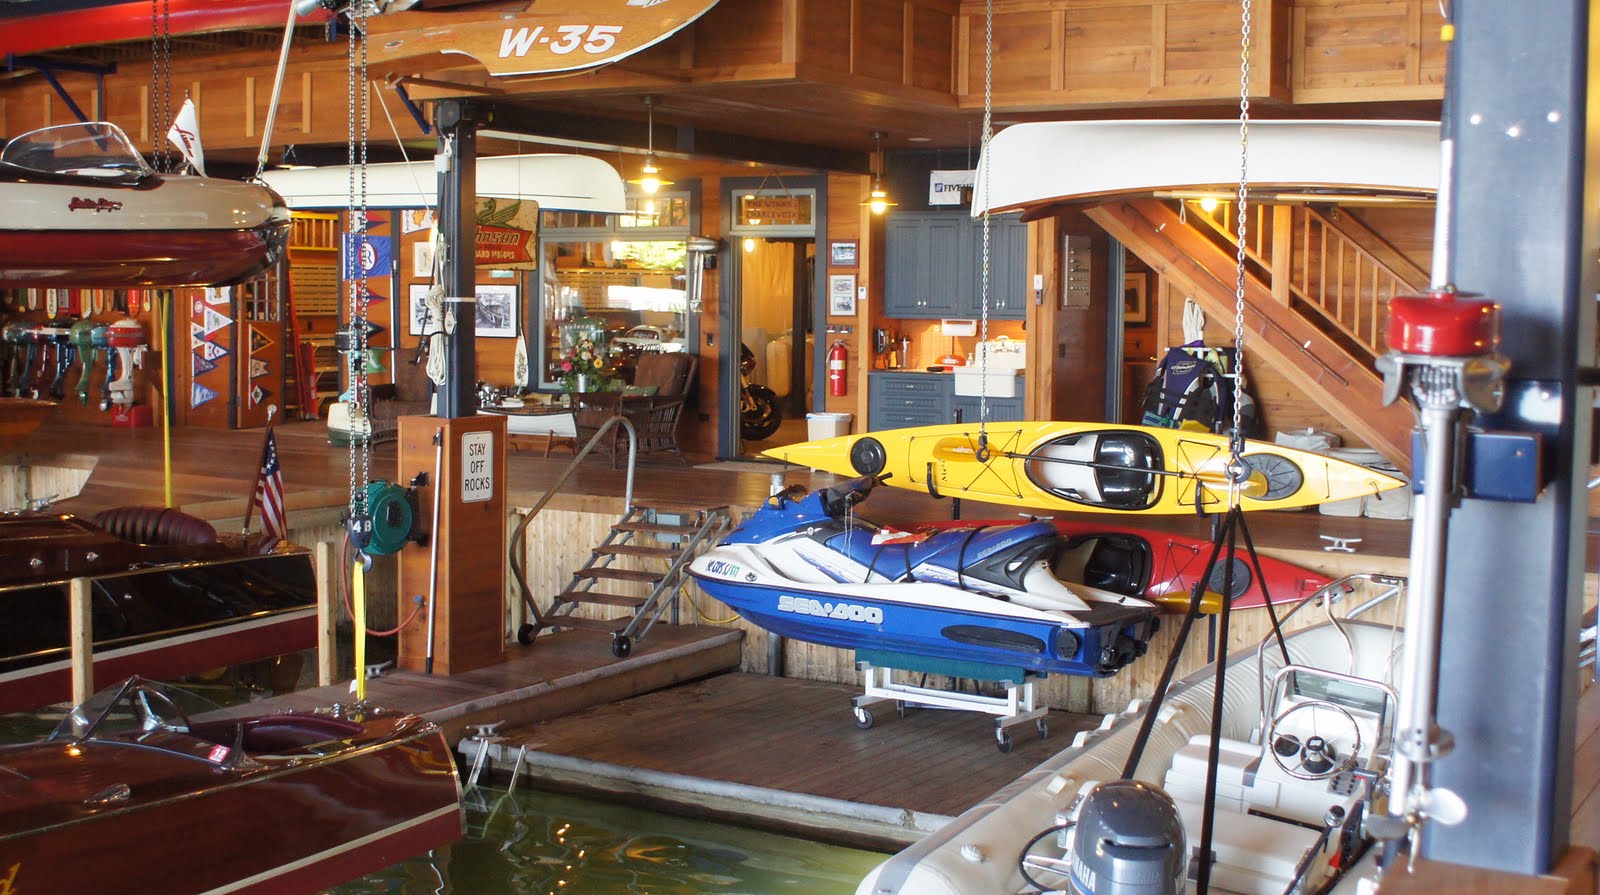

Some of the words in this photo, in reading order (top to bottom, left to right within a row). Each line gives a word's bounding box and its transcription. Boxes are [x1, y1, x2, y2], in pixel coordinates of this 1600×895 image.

[498, 25, 624, 58] W-35
[944, 184, 962, 192] FIVE
[475, 226, 520, 245] hnson
[469, 443, 487, 457] STAY
[470, 460, 485, 474] OFF
[464, 477, 490, 491] ROCKS
